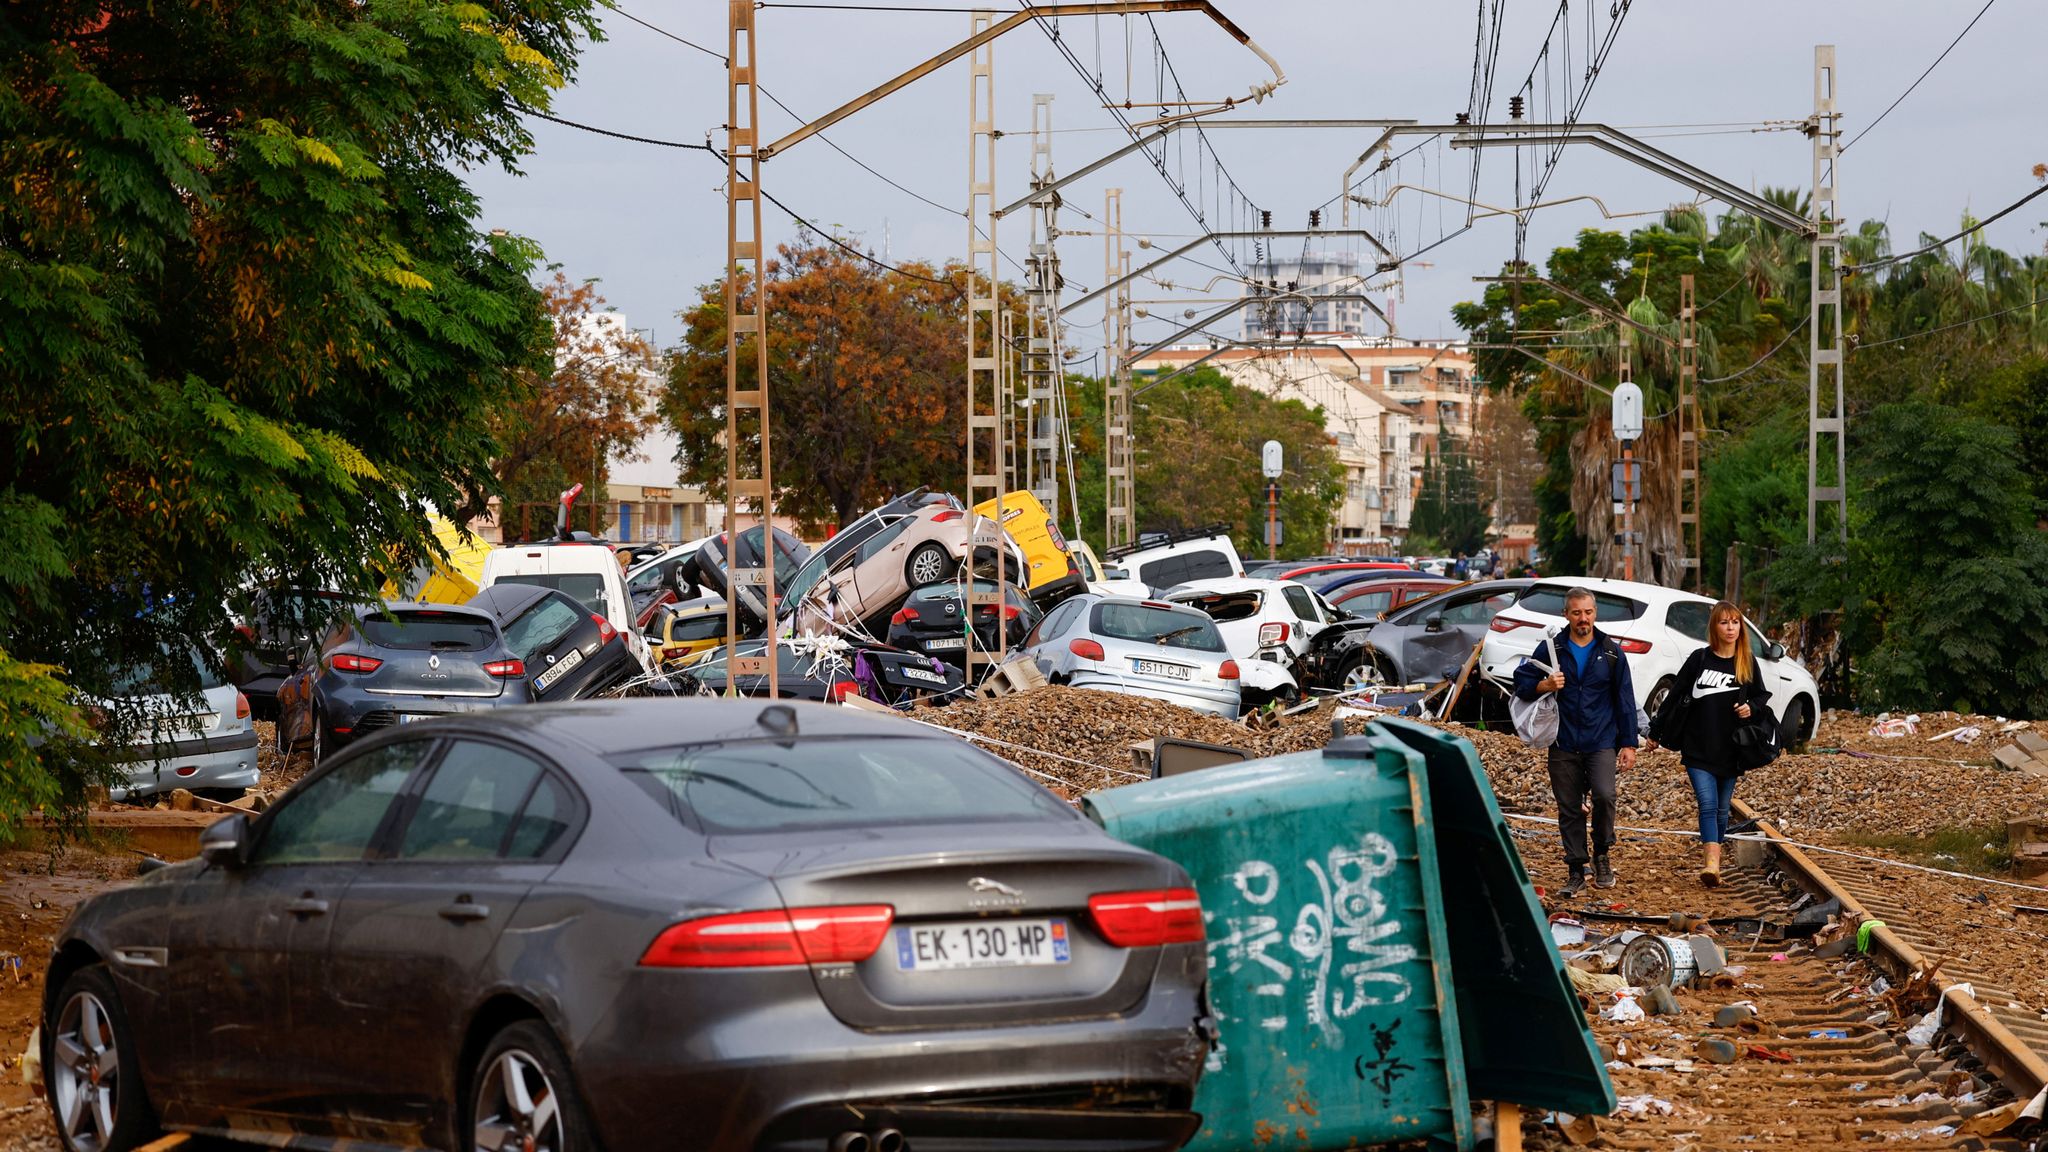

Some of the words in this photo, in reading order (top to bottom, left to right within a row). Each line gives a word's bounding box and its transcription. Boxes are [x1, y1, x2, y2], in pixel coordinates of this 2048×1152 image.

[932, 639, 950, 648] 1071
[541, 666, 561, 684] 1894
[561, 652, 578, 670] FCF
[1139, 661, 1164, 674] 6511
[1167, 665, 1189, 678] CJN
[1697, 668, 1735, 688] NIKE
